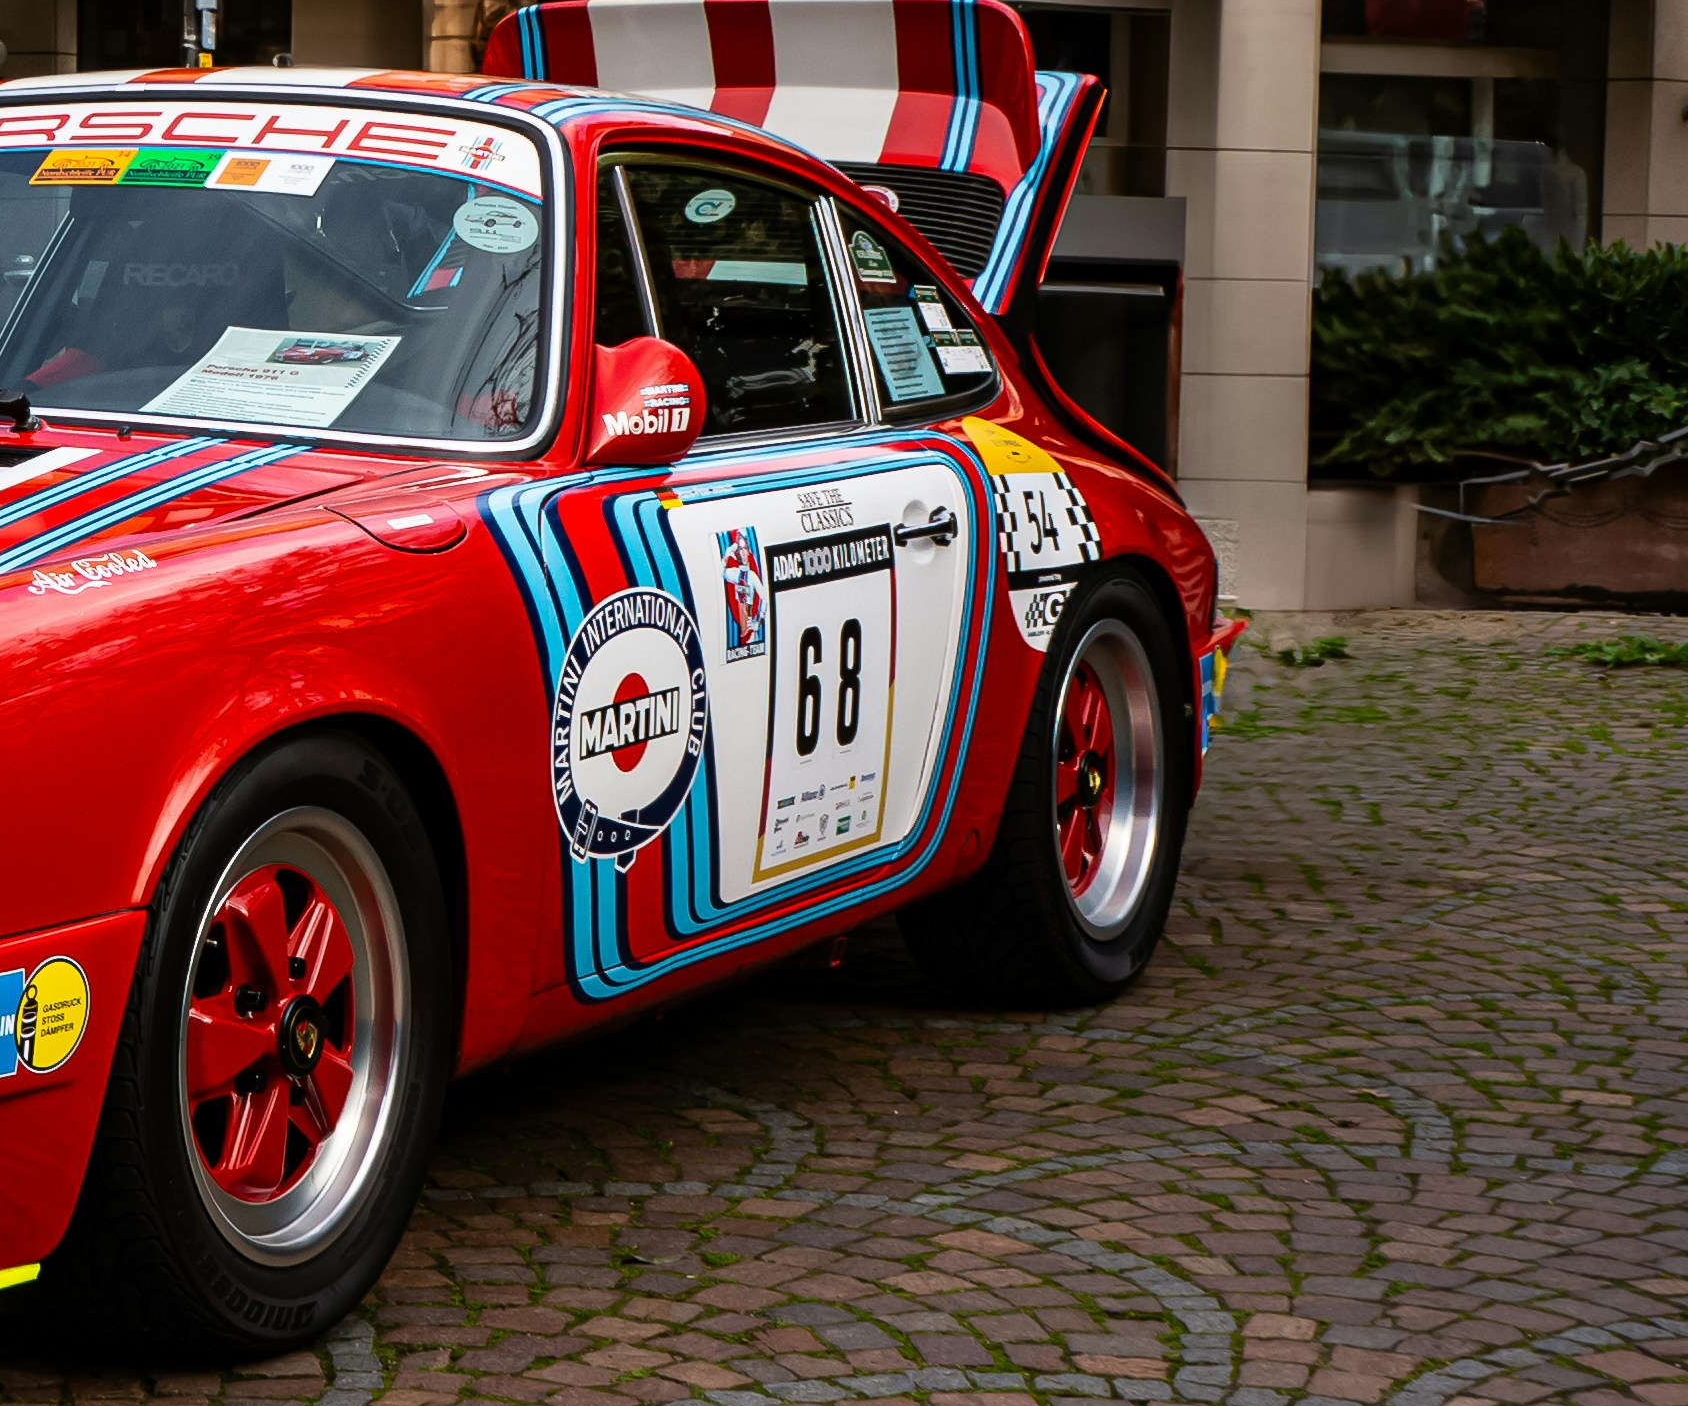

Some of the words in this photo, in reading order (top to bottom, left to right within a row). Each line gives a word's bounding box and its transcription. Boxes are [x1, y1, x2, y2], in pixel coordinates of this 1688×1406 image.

[205, 363, 258, 373] Porsche
[602, 408, 669, 437] Mobil
[800, 506, 854, 534] CLASSICS
[1022, 489, 1061, 555] 54
[27, 569, 76, 595] Air
[71, 549, 157, 581] Cooled
[773, 552, 803, 582] ADAC
[831, 535, 890, 570] KILOMETER
[554, 654, 583, 805] MARTINI
[581, 594, 693, 658] INTERNATIONAL
[688, 667, 706, 758] CLUB
[796, 617, 861, 757] 68
[580, 690, 680, 758] MARTINI
[41, 1012, 65, 1026] STOSS
[42, 997, 82, 1014] GASDRUCK
[40, 1022, 74, 1038] DÄMPFER
